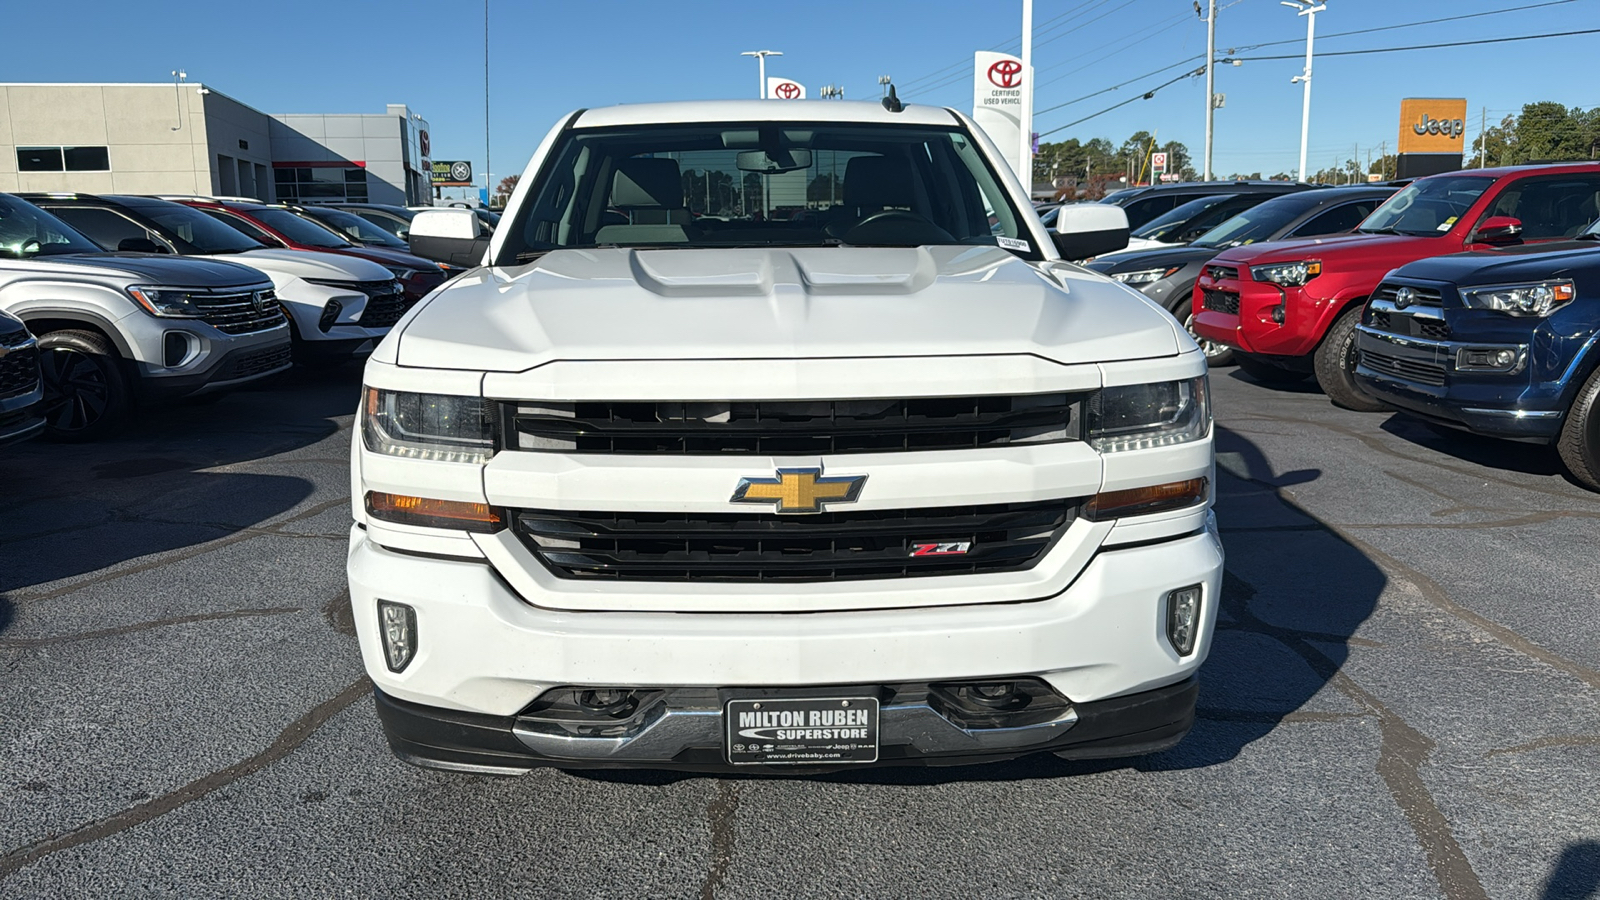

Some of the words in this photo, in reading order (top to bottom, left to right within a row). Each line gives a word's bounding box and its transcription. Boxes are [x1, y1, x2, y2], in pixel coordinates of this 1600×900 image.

[1413, 113, 1464, 139] Jeep
[909, 542, 971, 557] Z71
[739, 711, 805, 728] MILTON
[809, 709, 868, 726] RUBEN
[776, 728, 868, 740] SUPERSTORE
[832, 743, 850, 751] Jeep
